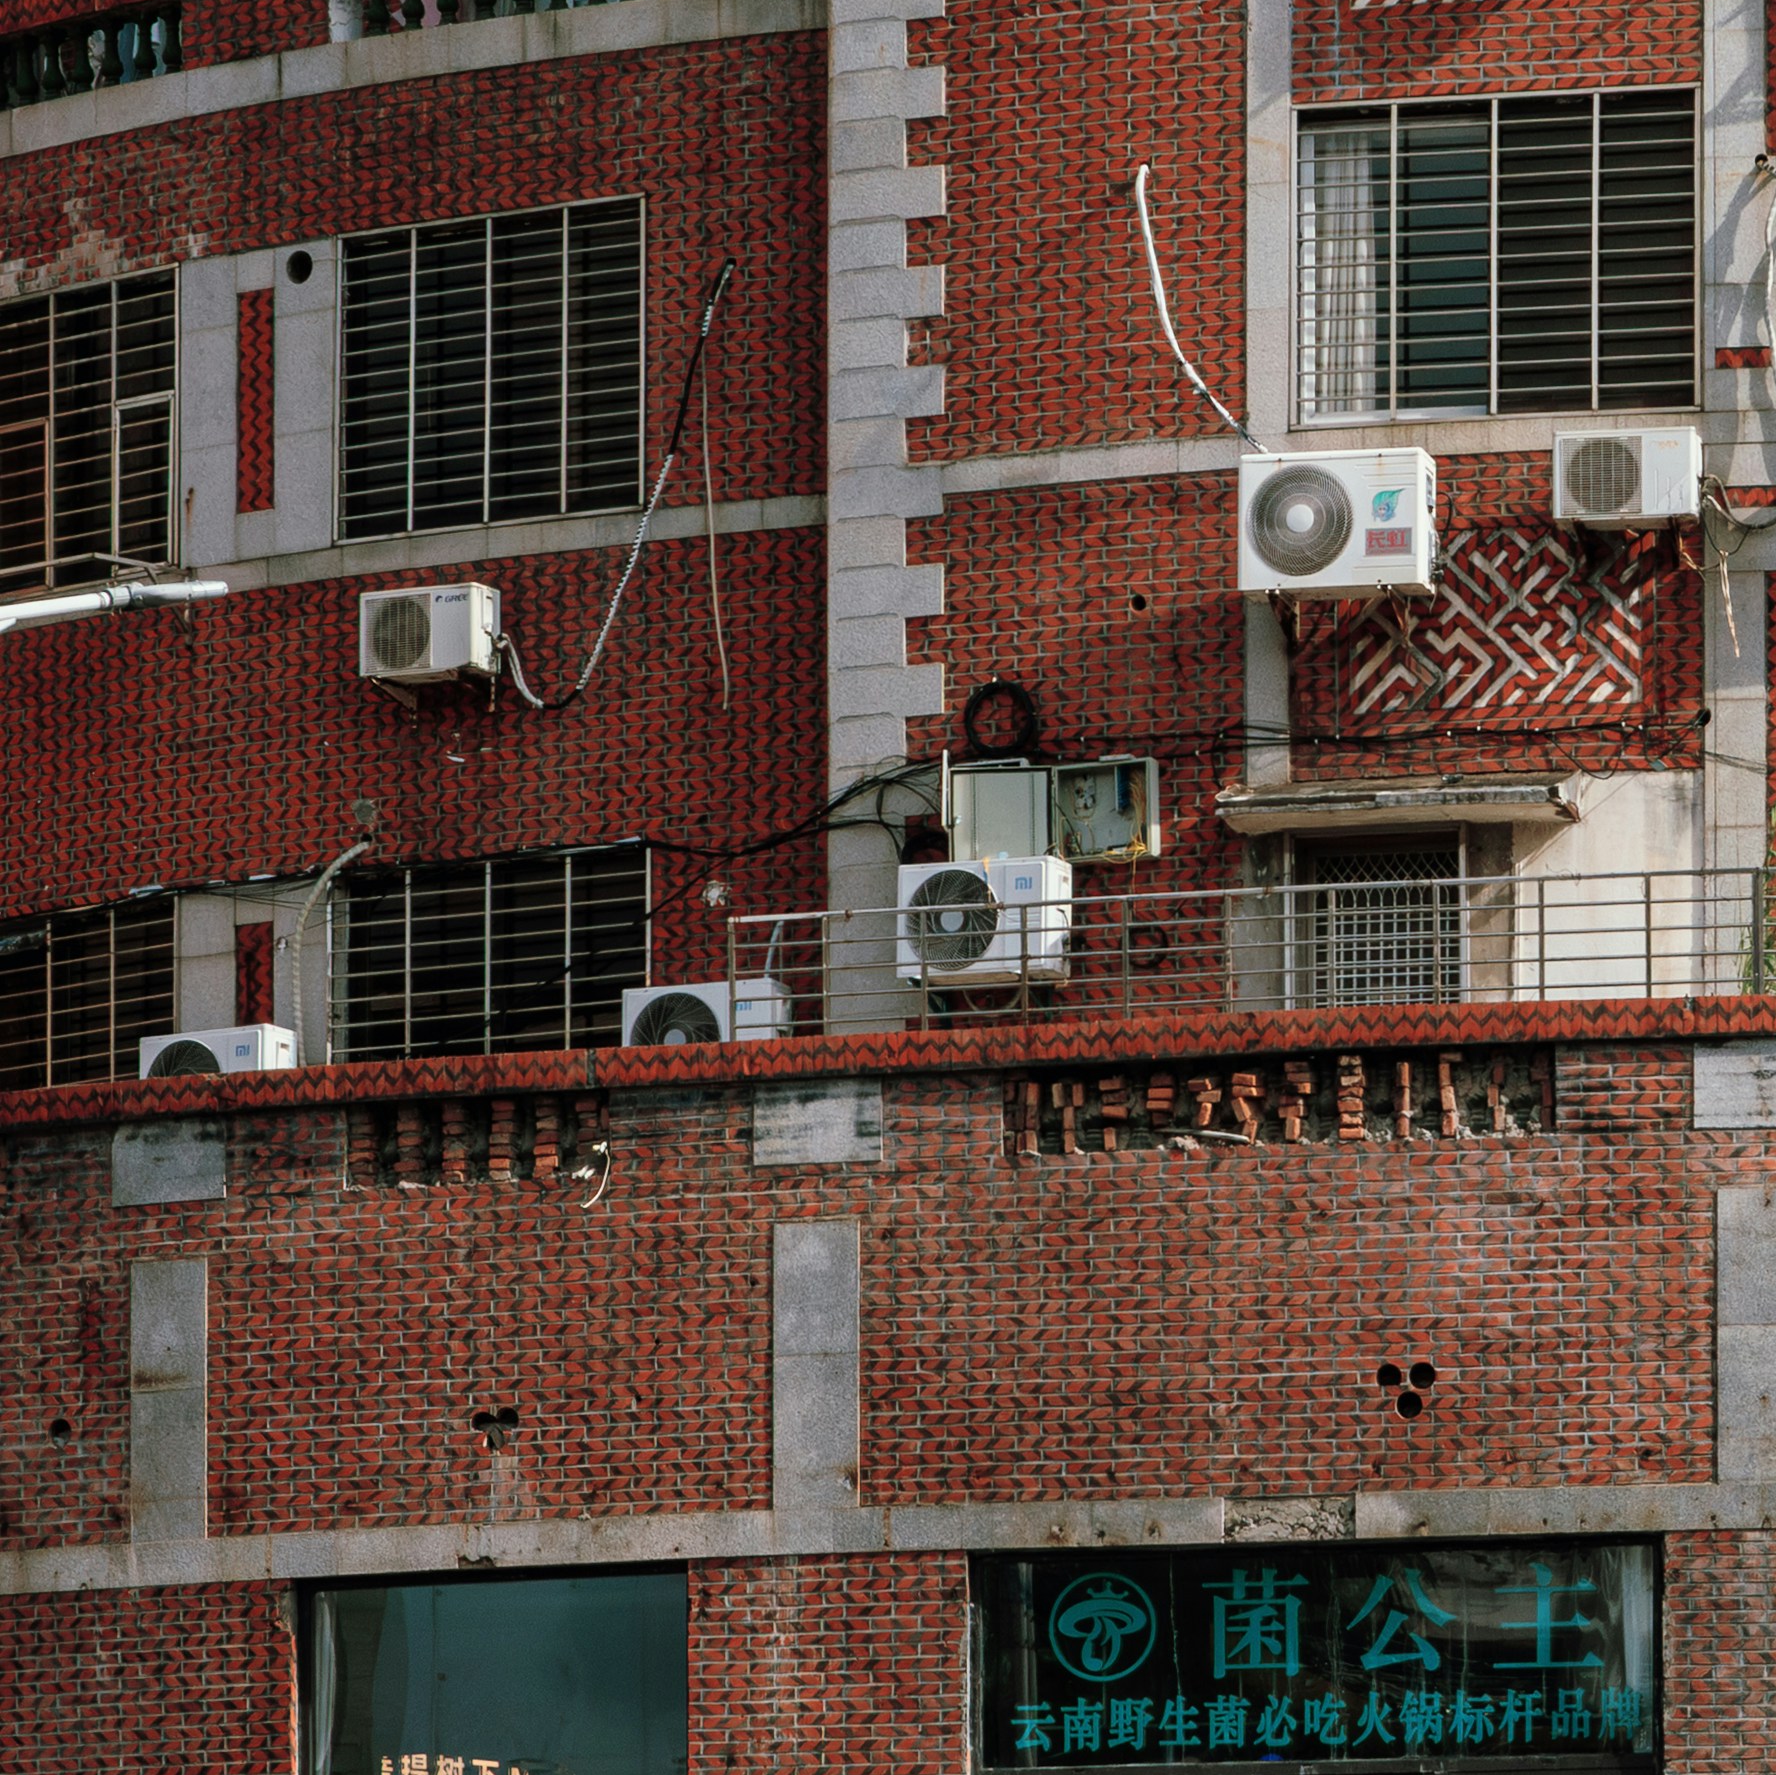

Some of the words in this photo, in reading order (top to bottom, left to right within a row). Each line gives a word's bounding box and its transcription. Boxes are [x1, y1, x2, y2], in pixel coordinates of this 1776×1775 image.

[1367, 529, 1408, 548] 长虹
[1201, 1563, 1605, 1680] 菌公主
[1010, 1686, 1642, 1753] 云南野生菌必吃火锅标杆品牌
